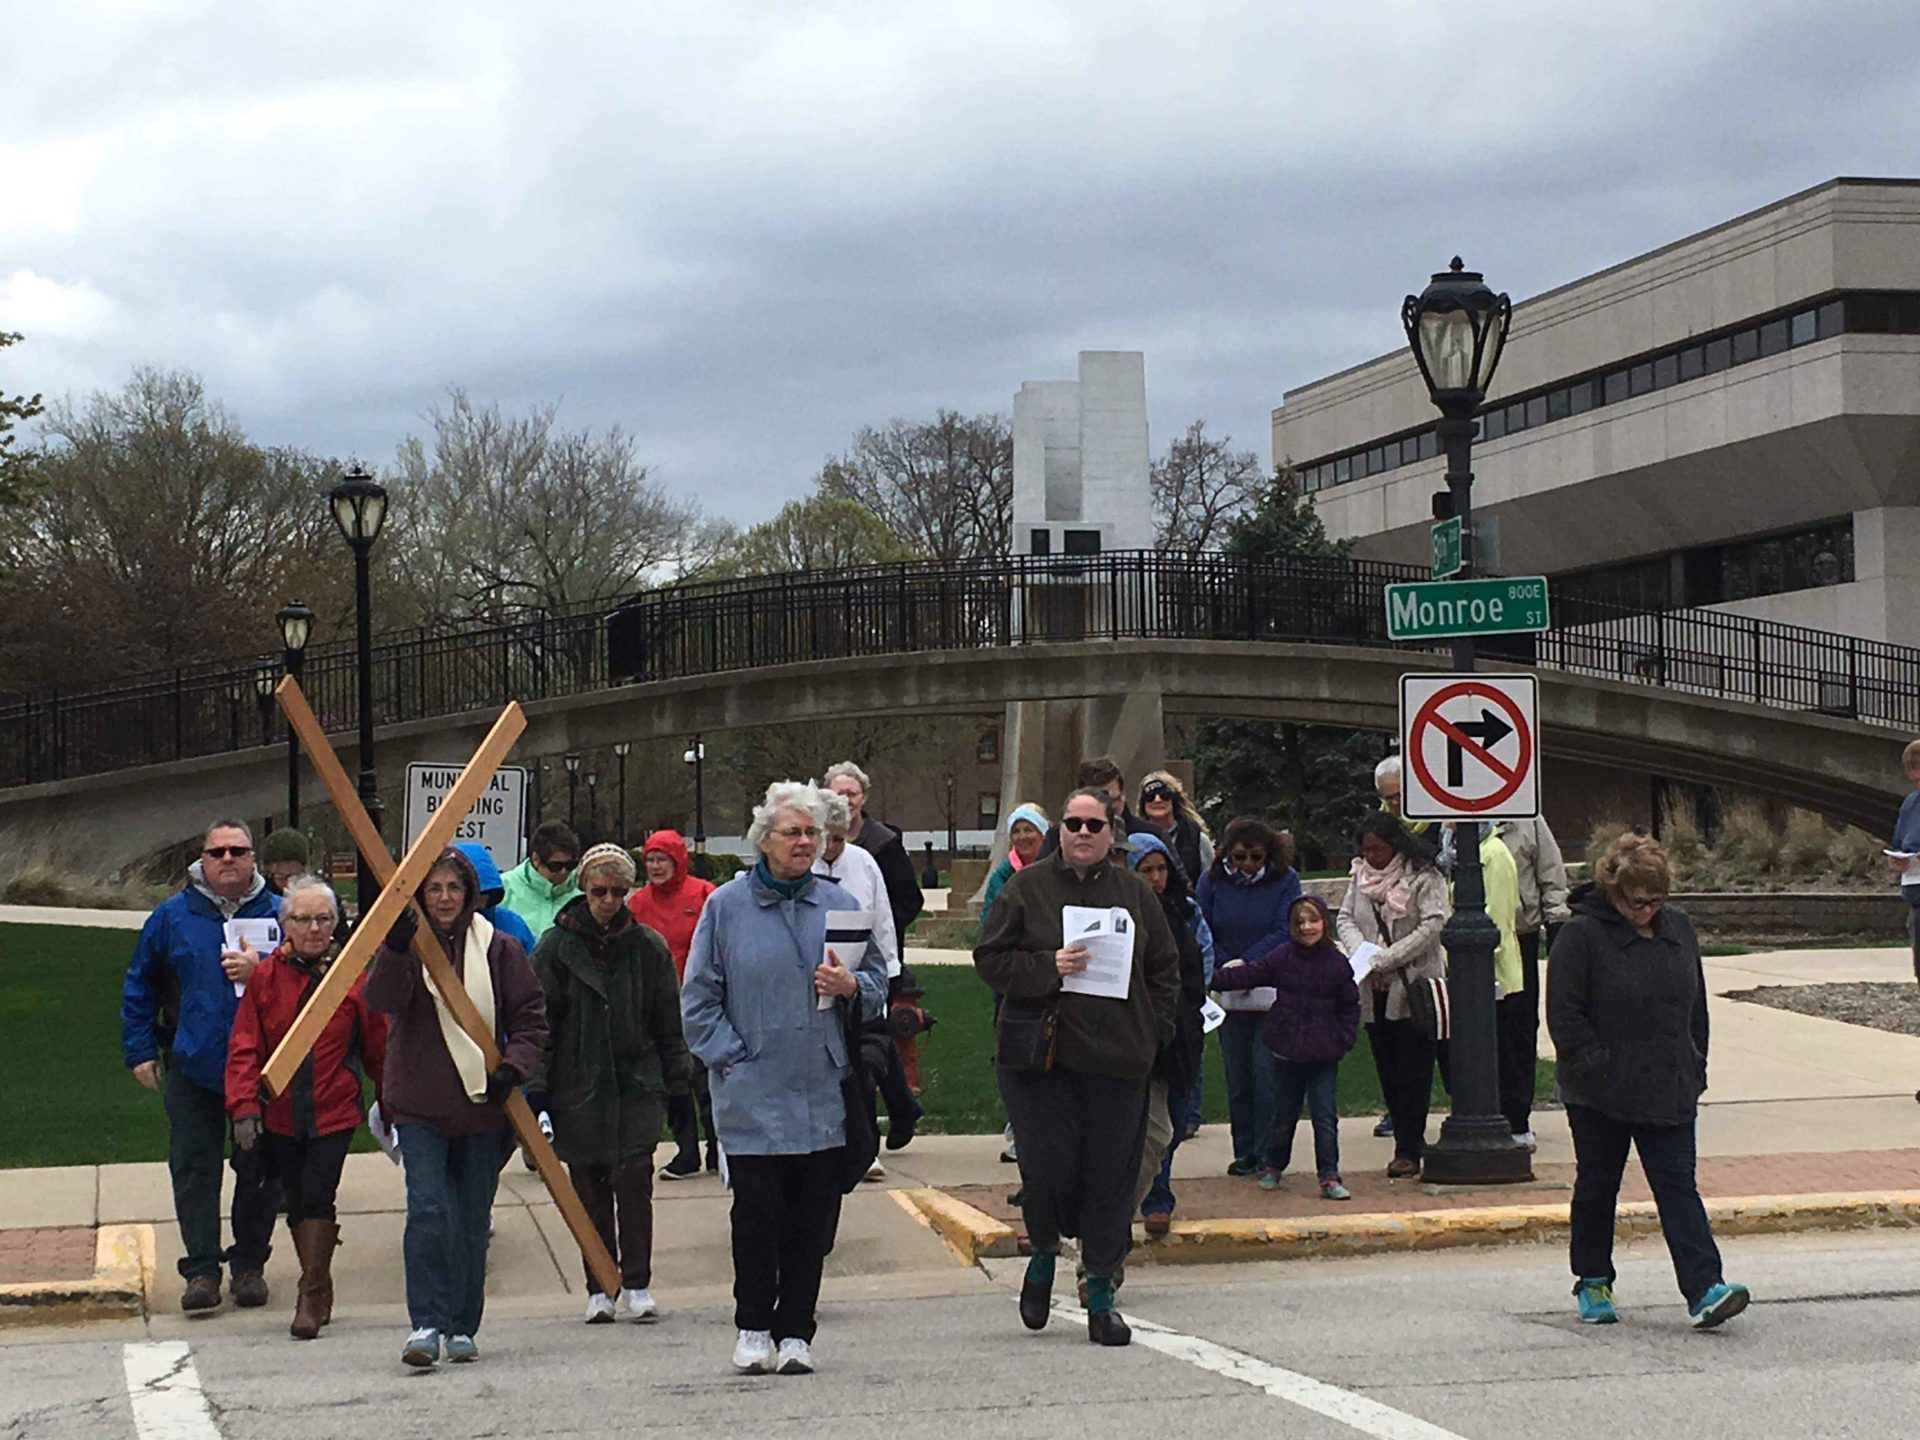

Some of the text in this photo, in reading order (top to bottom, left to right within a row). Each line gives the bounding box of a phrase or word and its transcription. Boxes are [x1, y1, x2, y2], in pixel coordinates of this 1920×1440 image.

[1508, 584, 1541, 599] 800E
[1392, 591, 1504, 631] Monroe
[1526, 610, 1542, 625] ST
[421, 771, 510, 792] MUNAL
[427, 796, 504, 815] BING
[454, 821, 486, 839] EST
